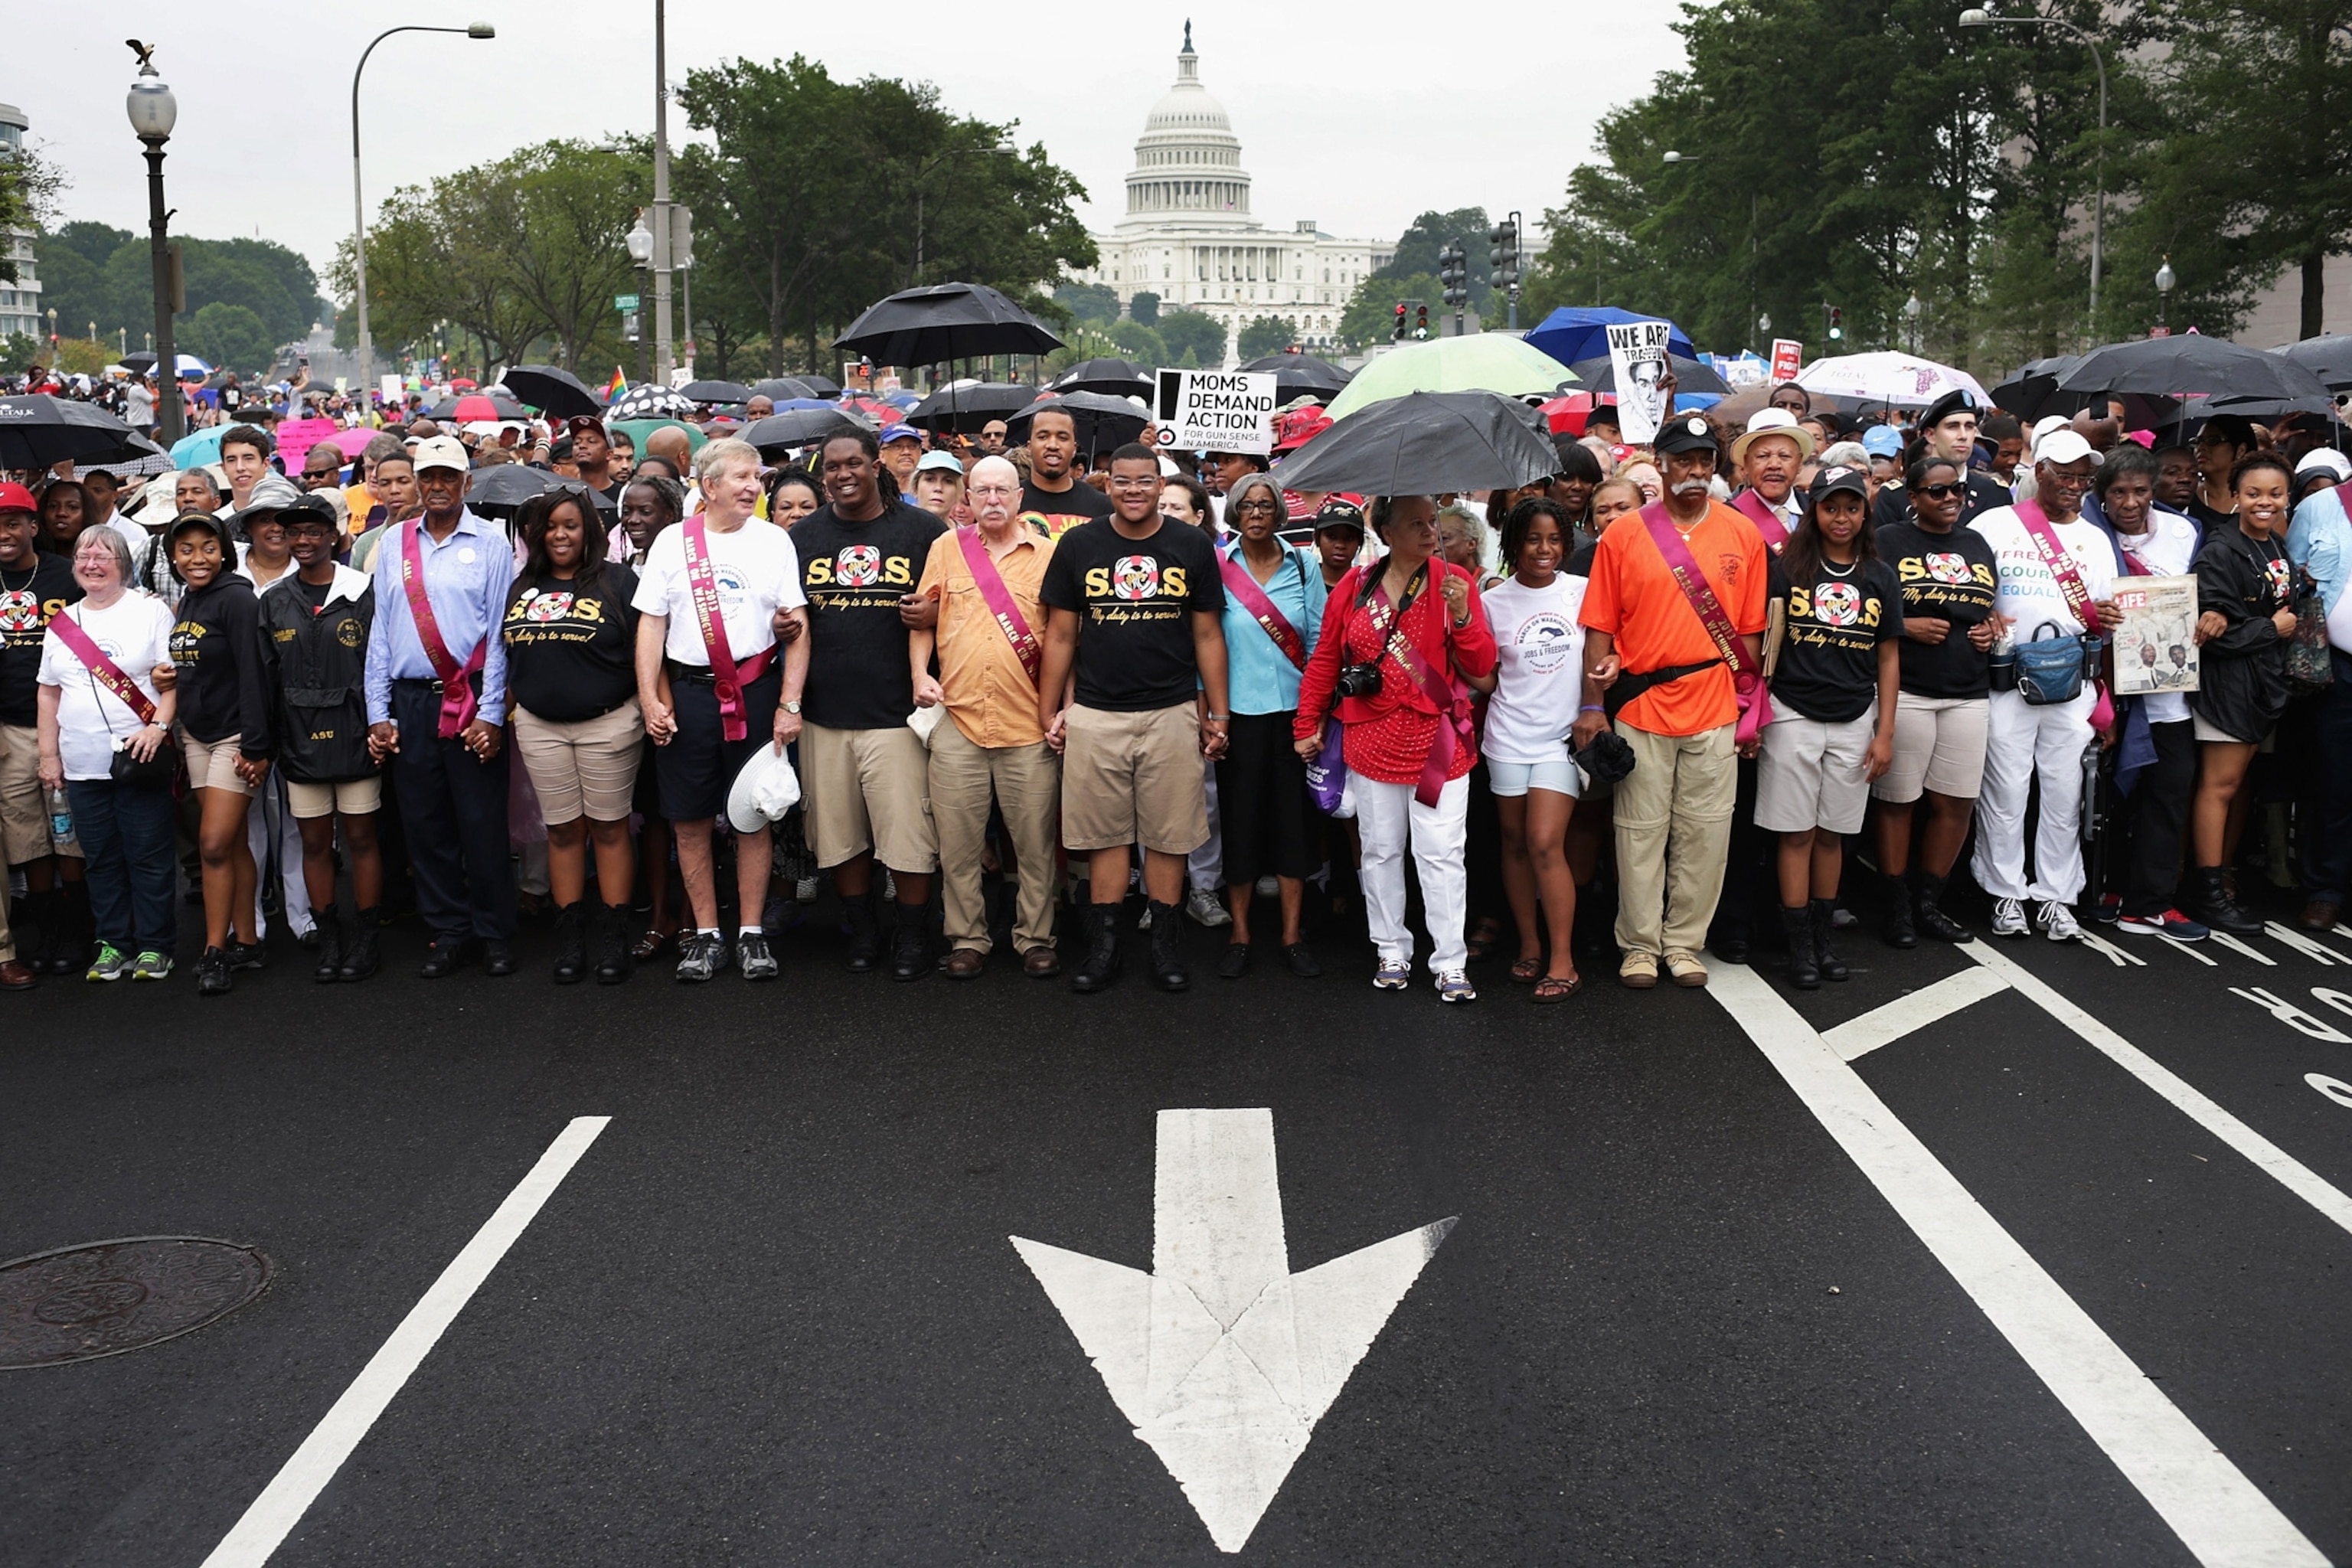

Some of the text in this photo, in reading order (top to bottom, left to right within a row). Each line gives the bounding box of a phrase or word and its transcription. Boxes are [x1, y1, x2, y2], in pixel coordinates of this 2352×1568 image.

[1609, 327, 1640, 348] WE
[1190, 374, 1248, 392] MOMS
[1188, 393, 1272, 412] DEMAND
[1185, 412, 1258, 430] ACTION
[1184, 430, 1261, 442] FOR GUN SENSE
[1195, 440, 1240, 449] AMERICA
[2033, 532, 2056, 560] MARCH
[2051, 562, 2065, 577] ON
[685, 535, 716, 645] MARCH ON WASHINGTON
[698, 557, 719, 612] 1963 2013
[2071, 579, 2088, 603] 2013
[828, 593, 850, 612] duty
[1923, 586, 1948, 605] duty
[1106, 606, 1130, 626] duty
[1673, 565, 1742, 672] MARCH ON WASHINGTON
[1701, 588, 1736, 641] 1963 2013
[996, 612, 1021, 644] MARCH
[1804, 629, 1827, 648] duty
[1373, 616, 1385, 630] ON
[1387, 639, 1426, 686] ASHINGTON
[1524, 649, 1538, 659] JOBS
[1544, 643, 1571, 655] FREEDOM
[310, 730, 335, 740] ASU
